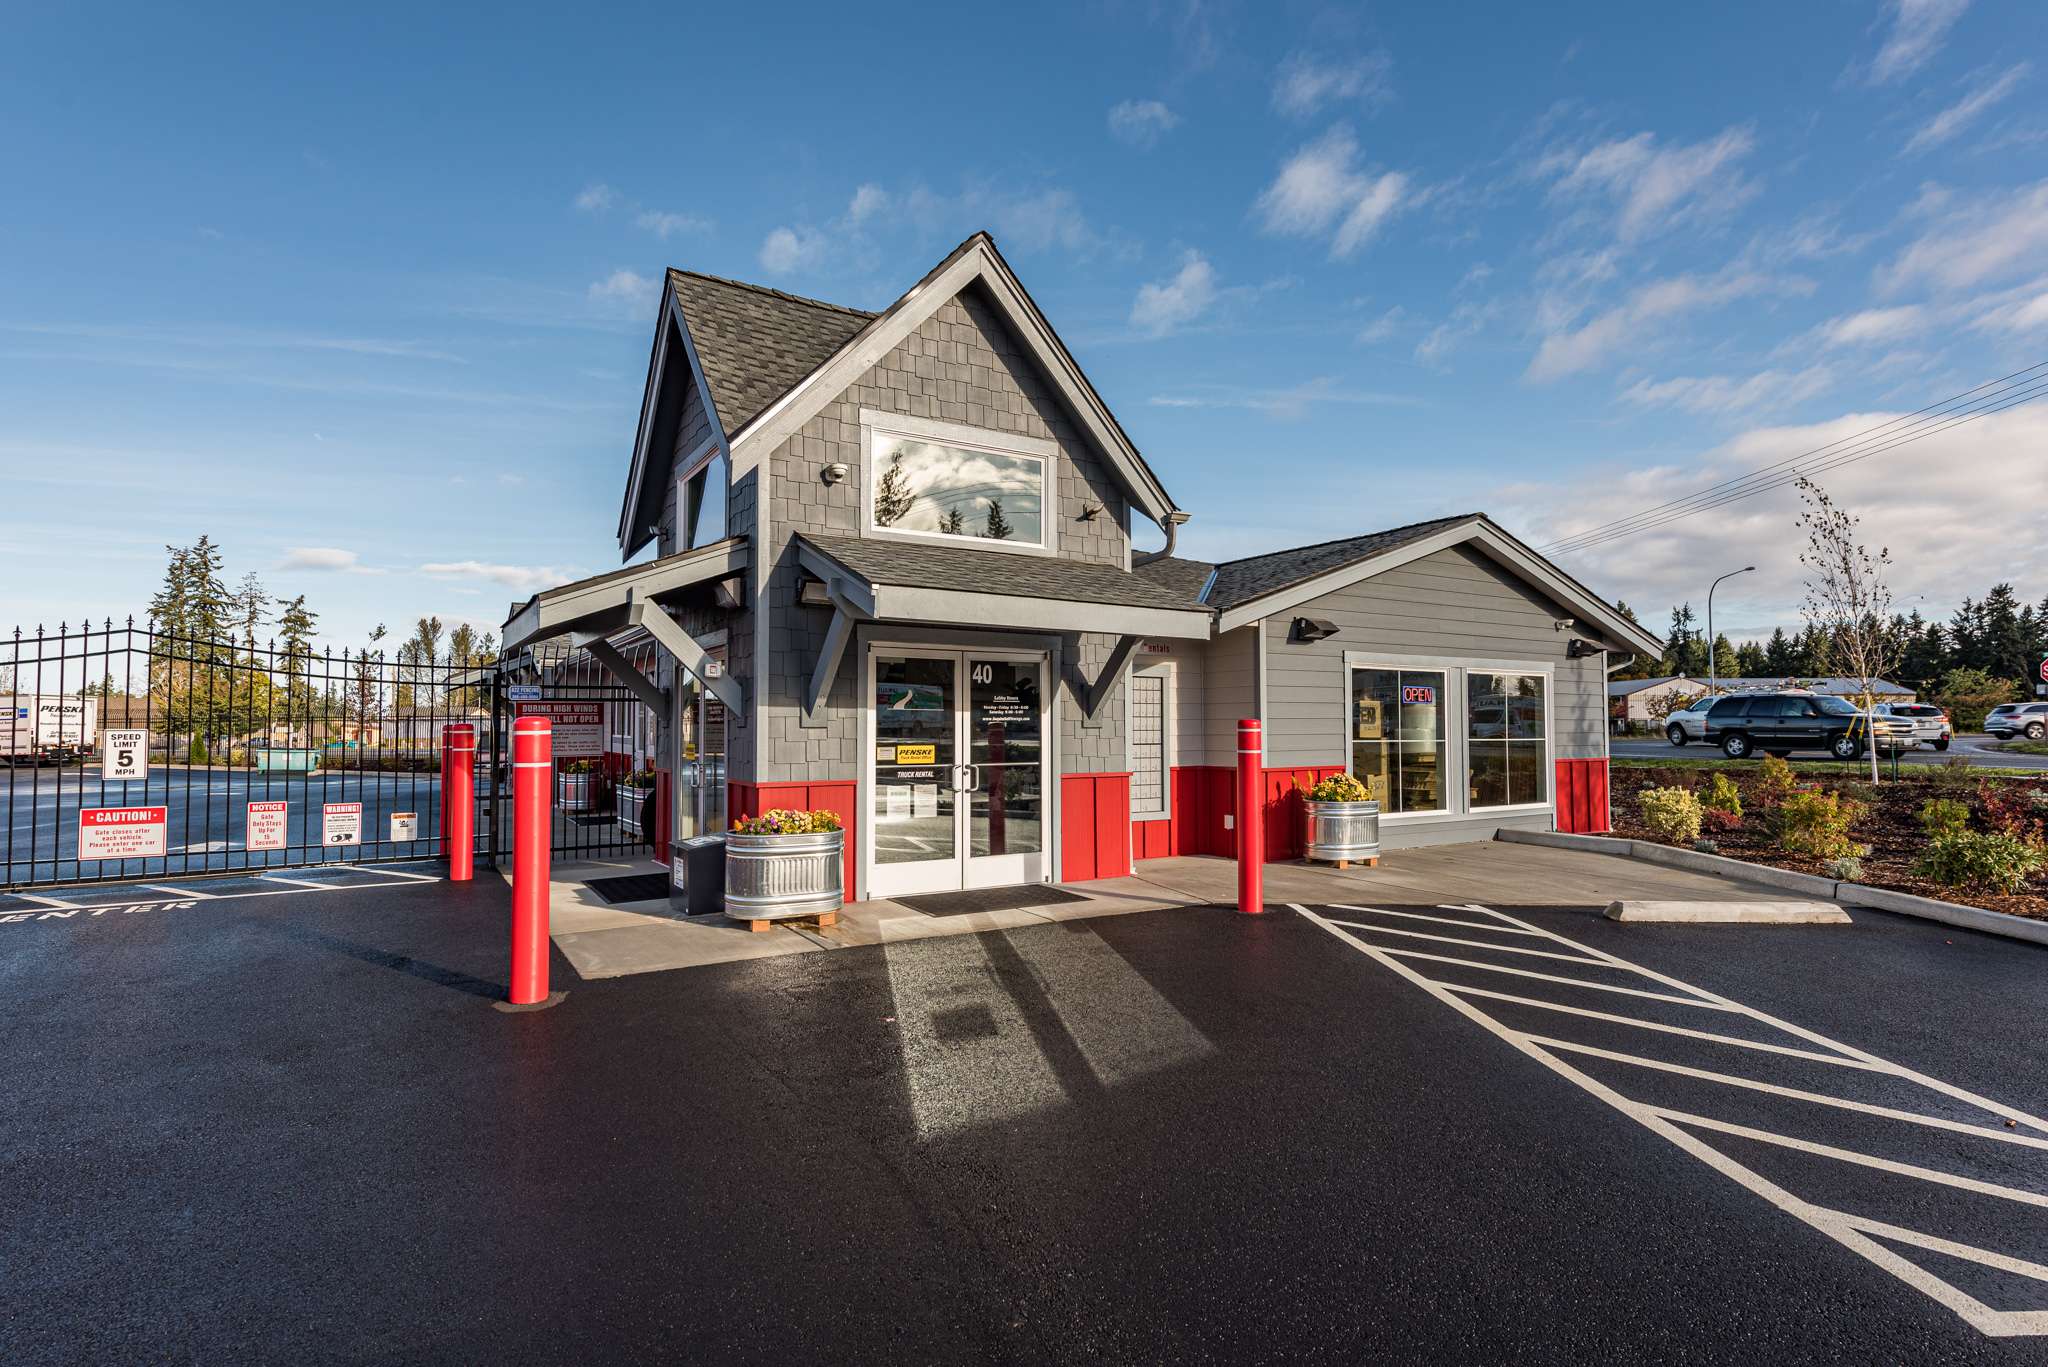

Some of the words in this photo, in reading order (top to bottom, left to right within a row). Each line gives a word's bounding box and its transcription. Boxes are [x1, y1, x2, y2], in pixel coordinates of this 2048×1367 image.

[972, 664, 993, 684] 40
[1404, 688, 1432, 702] OPEN
[522, 704, 552, 713] DURING
[553, 704, 572, 713] HIGH
[573, 704, 599, 713] WINDS
[546, 715, 561, 723] ILL
[563, 715, 578, 723] NOT
[579, 715, 599, 723] OPEN
[117, 750, 134, 767] 5
[897, 771, 915, 779] TRUCK
[915, 770, 935, 778] RENTAL
[252, 803, 283, 811] NOTICE
[326, 804, 359, 813] WARNING!
[96, 811, 152, 823] CAUTION!
[0, 901, 197, 923] ENTER
